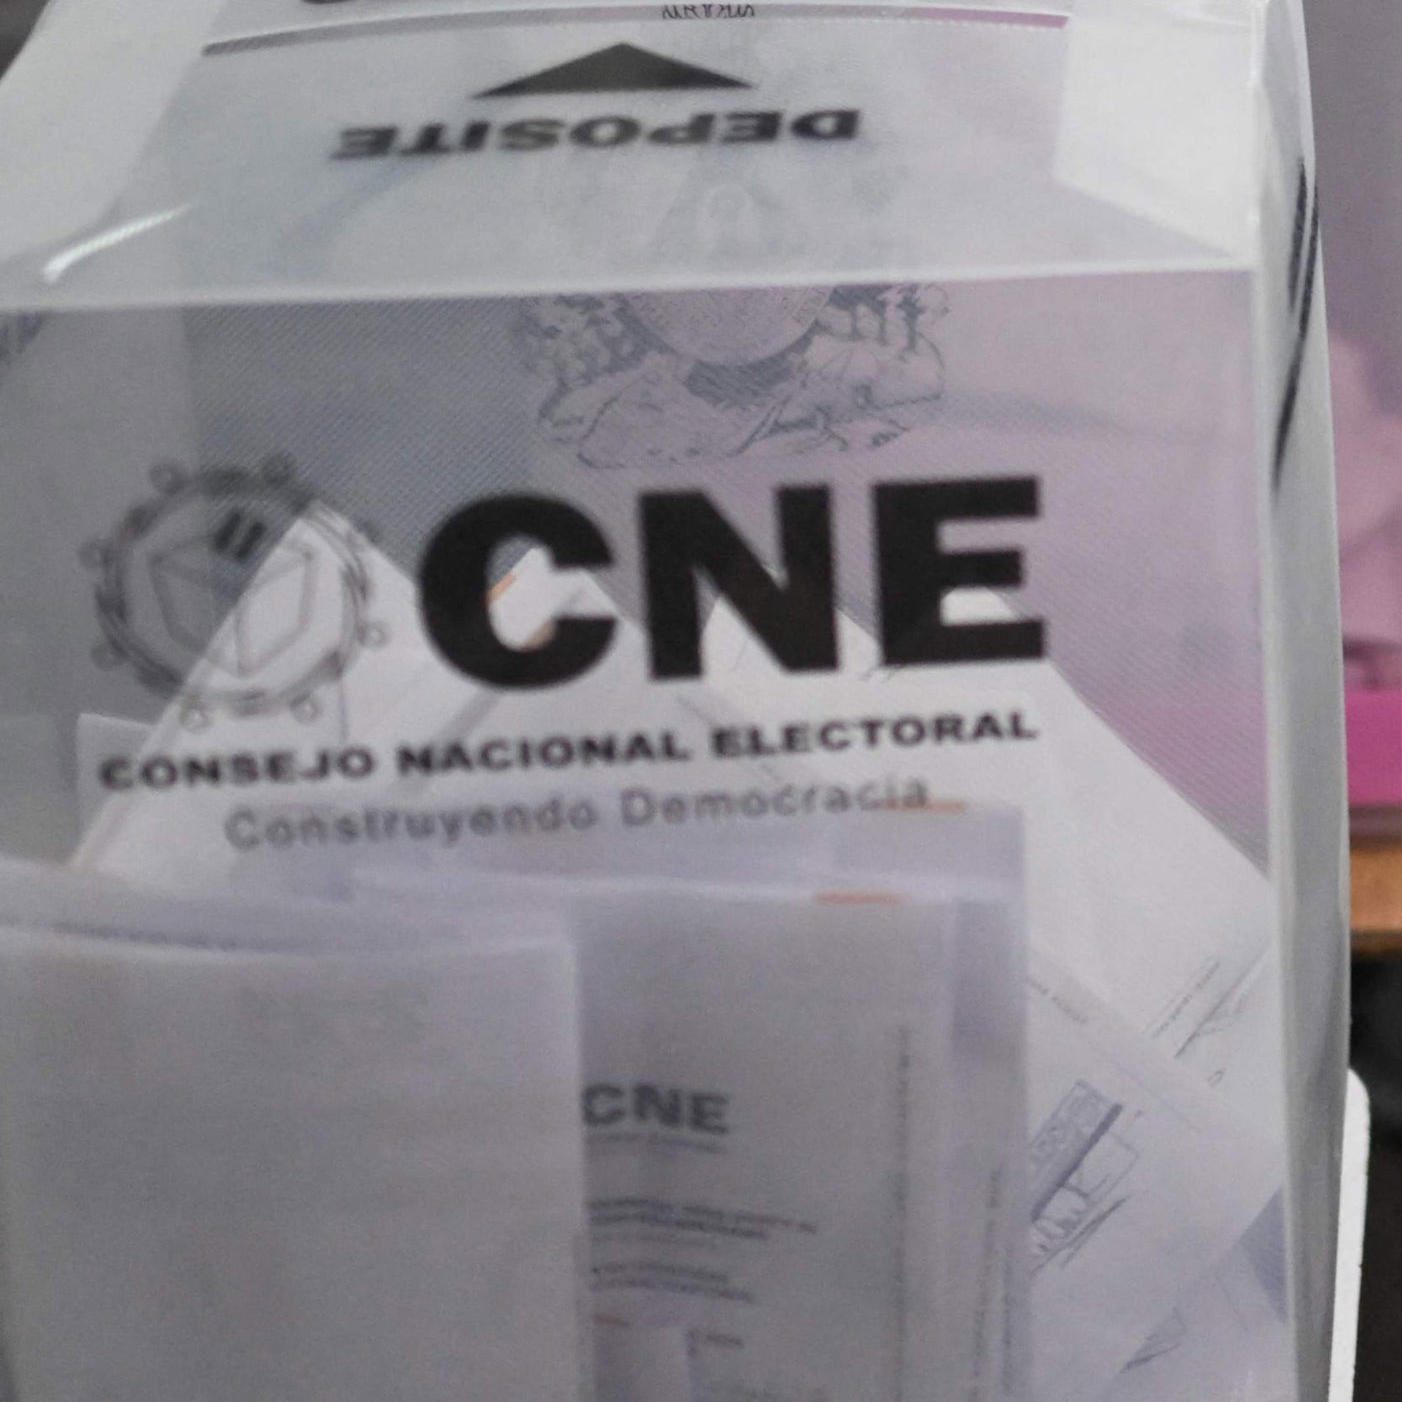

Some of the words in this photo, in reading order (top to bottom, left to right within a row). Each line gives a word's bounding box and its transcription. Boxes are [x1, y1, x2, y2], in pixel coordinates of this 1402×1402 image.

[330, 109, 861, 160] DEPOSITE
[417, 474, 1048, 691] CNE
[101, 745, 376, 791] CONSEJO
[396, 729, 692, 777] NACIONAL
[709, 710, 1039, 759] ELECTORAL
[224, 798, 599, 850] Construyendo
[620, 774, 930, 828] Democracia
[582, 1081, 731, 1137] CNE
